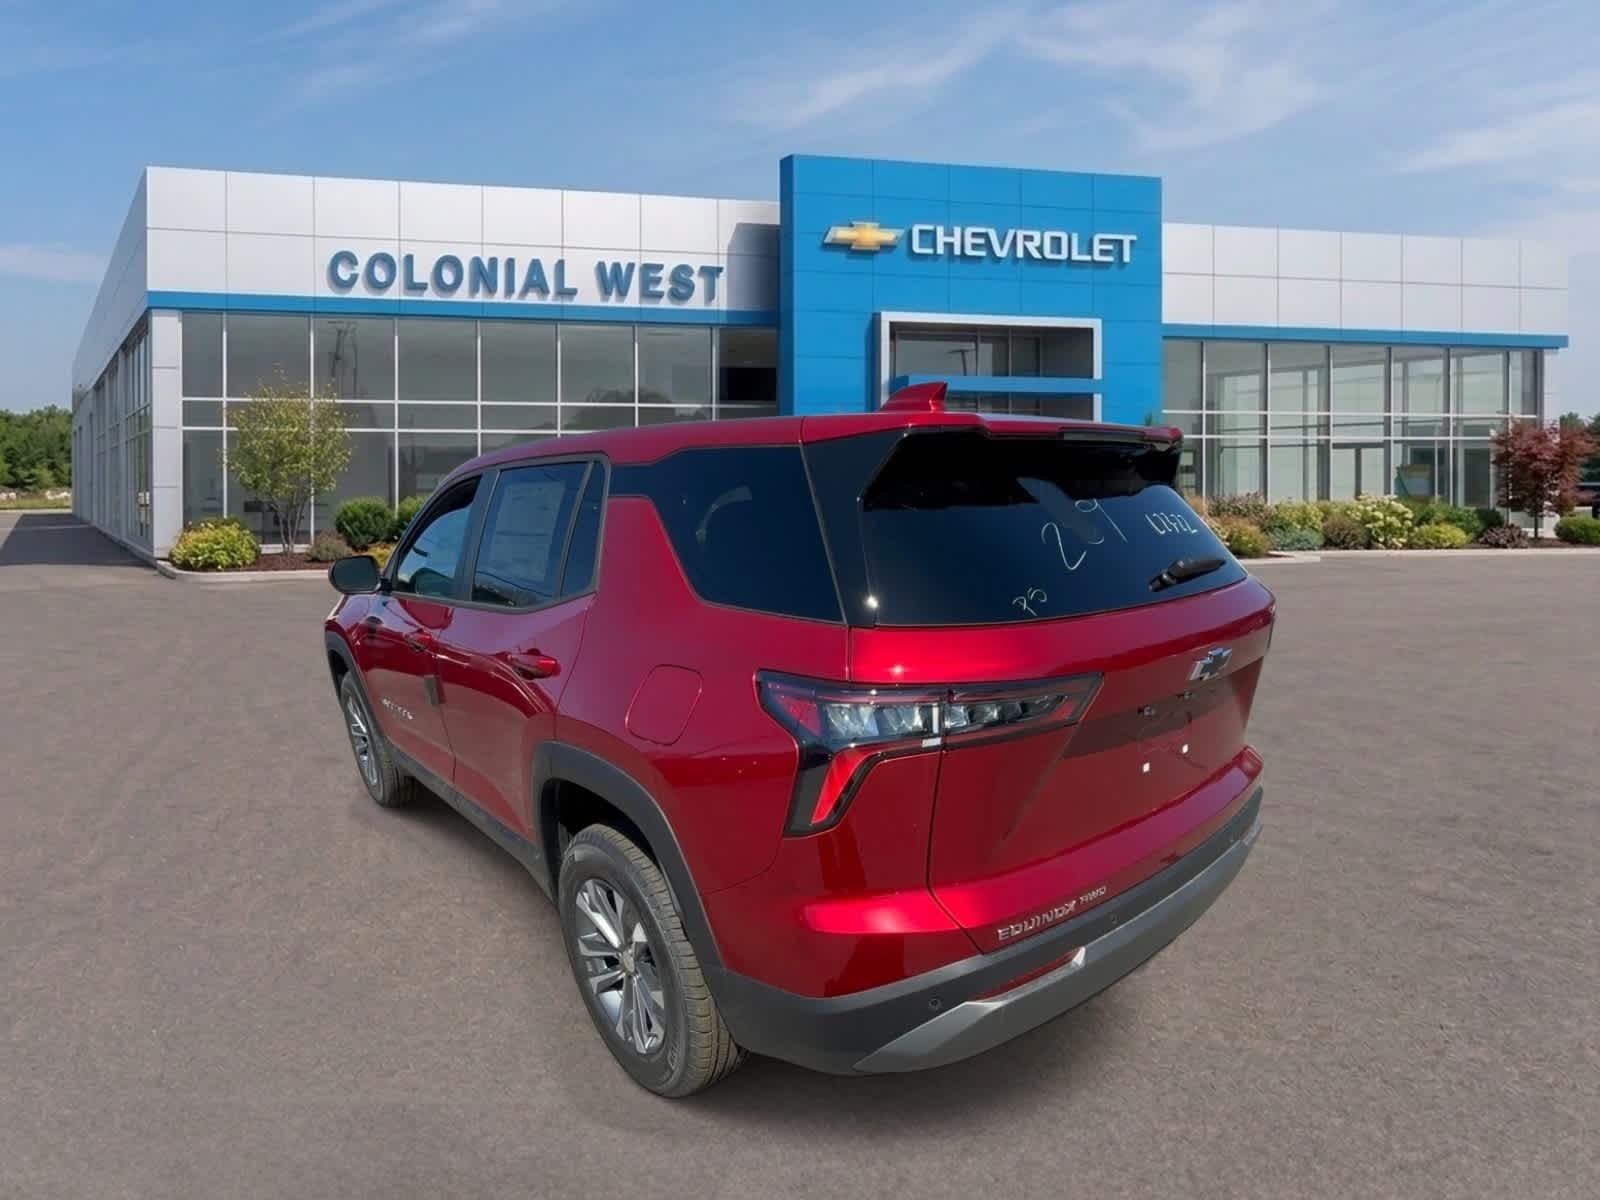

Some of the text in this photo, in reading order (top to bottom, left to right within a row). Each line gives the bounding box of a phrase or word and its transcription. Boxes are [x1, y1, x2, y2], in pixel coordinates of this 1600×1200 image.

[911, 223, 1138, 264] CHEVROLET
[328, 250, 724, 305] COLONIAL WEST
[997, 900, 1077, 941] EQUINOX
